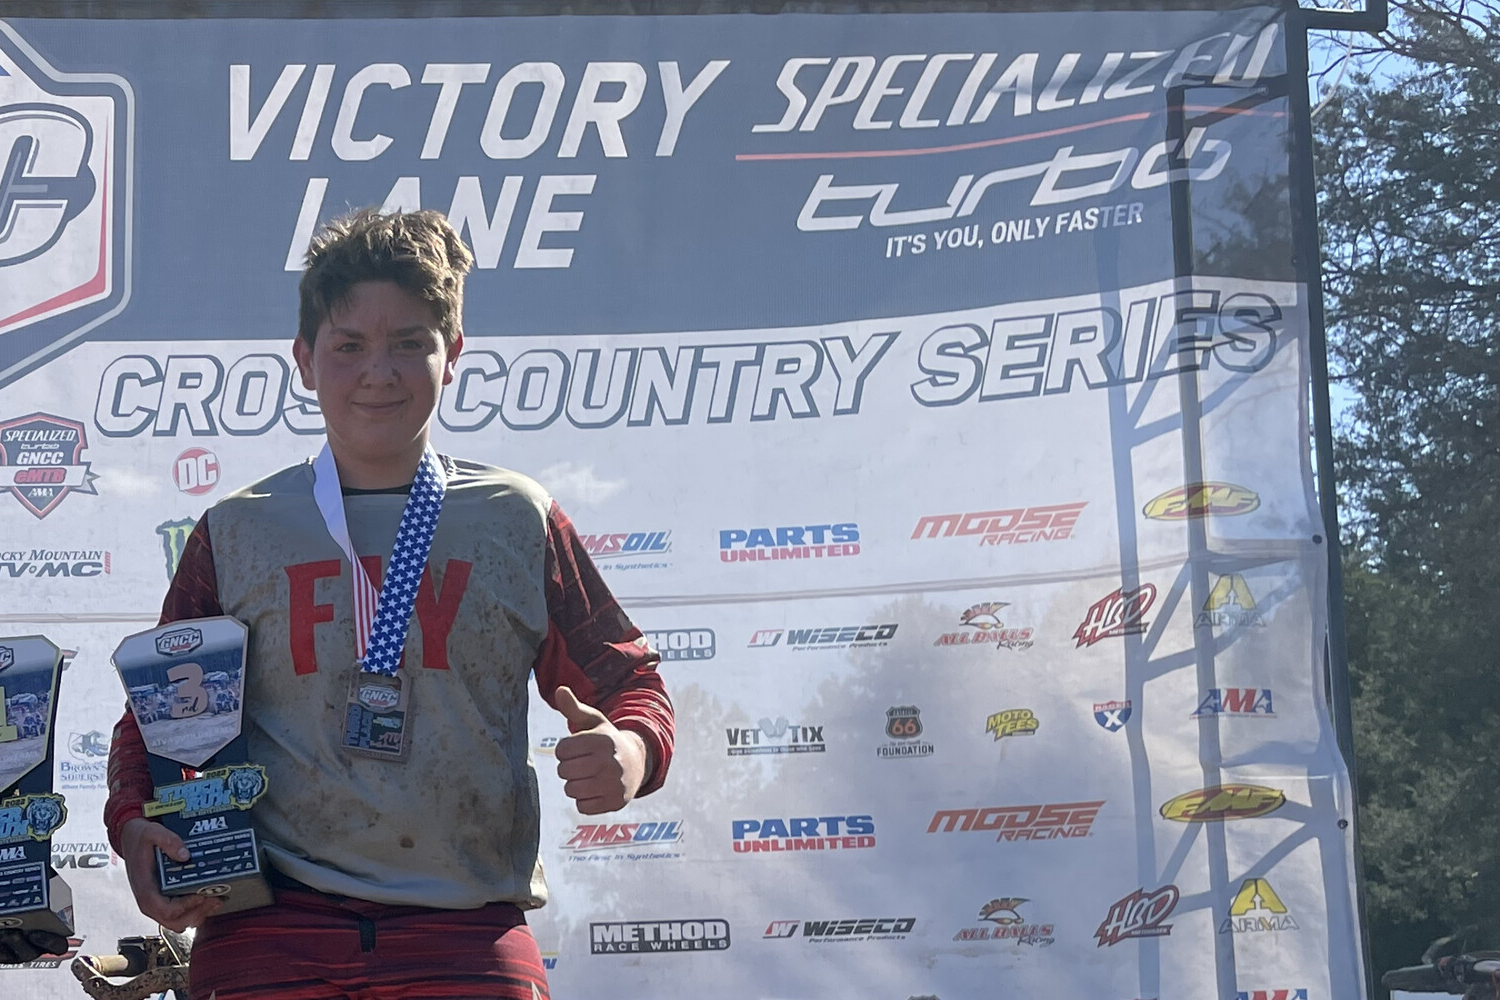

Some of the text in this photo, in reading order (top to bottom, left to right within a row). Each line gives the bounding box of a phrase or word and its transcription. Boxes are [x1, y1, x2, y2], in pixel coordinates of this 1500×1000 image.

[752, 23, 1280, 133] SPECIALIZED
[229, 60, 730, 161] VICTORY
[886, 202, 1145, 259] IT'S YOU, ONLY FASTER
[436, 331, 899, 432] COUNTRY
[911, 290, 1282, 406] SERIES
[3, 429, 77, 443] SPECIALIZED
[15, 452, 64, 465] GNCC
[177, 453, 218, 490] DC
[910, 501, 1089, 540] MOOSE
[719, 523, 861, 549] PARTS
[978, 527, 1073, 547] RACING
[31, 549, 103, 562] MOUNTAIN
[720, 543, 861, 563] UNLIMITED
[284, 555, 473, 677] FY
[160, 632, 200, 650] GNCC
[786, 624, 899, 645] WISECO
[166, 662, 209, 719] 3
[361, 689, 398, 702] GNCC
[1194, 688, 1274, 714] AMA
[891, 717, 917, 734] 66
[1104, 709, 1123, 728] X
[726, 726, 825, 746] VET TIX
[876, 743, 935, 757] FOUNDATION
[189, 816, 228, 836] AMA
[925, 800, 1106, 833] MOOSE
[569, 820, 684, 847] AMSOIL
[732, 815, 876, 840] PARTS
[995, 824, 1092, 842] RACING
[732, 835, 876, 853] UNLIMITED
[593, 920, 728, 943] METHOD
[802, 918, 917, 937] WISECO
[593, 938, 728, 952] RACE WHEELS
